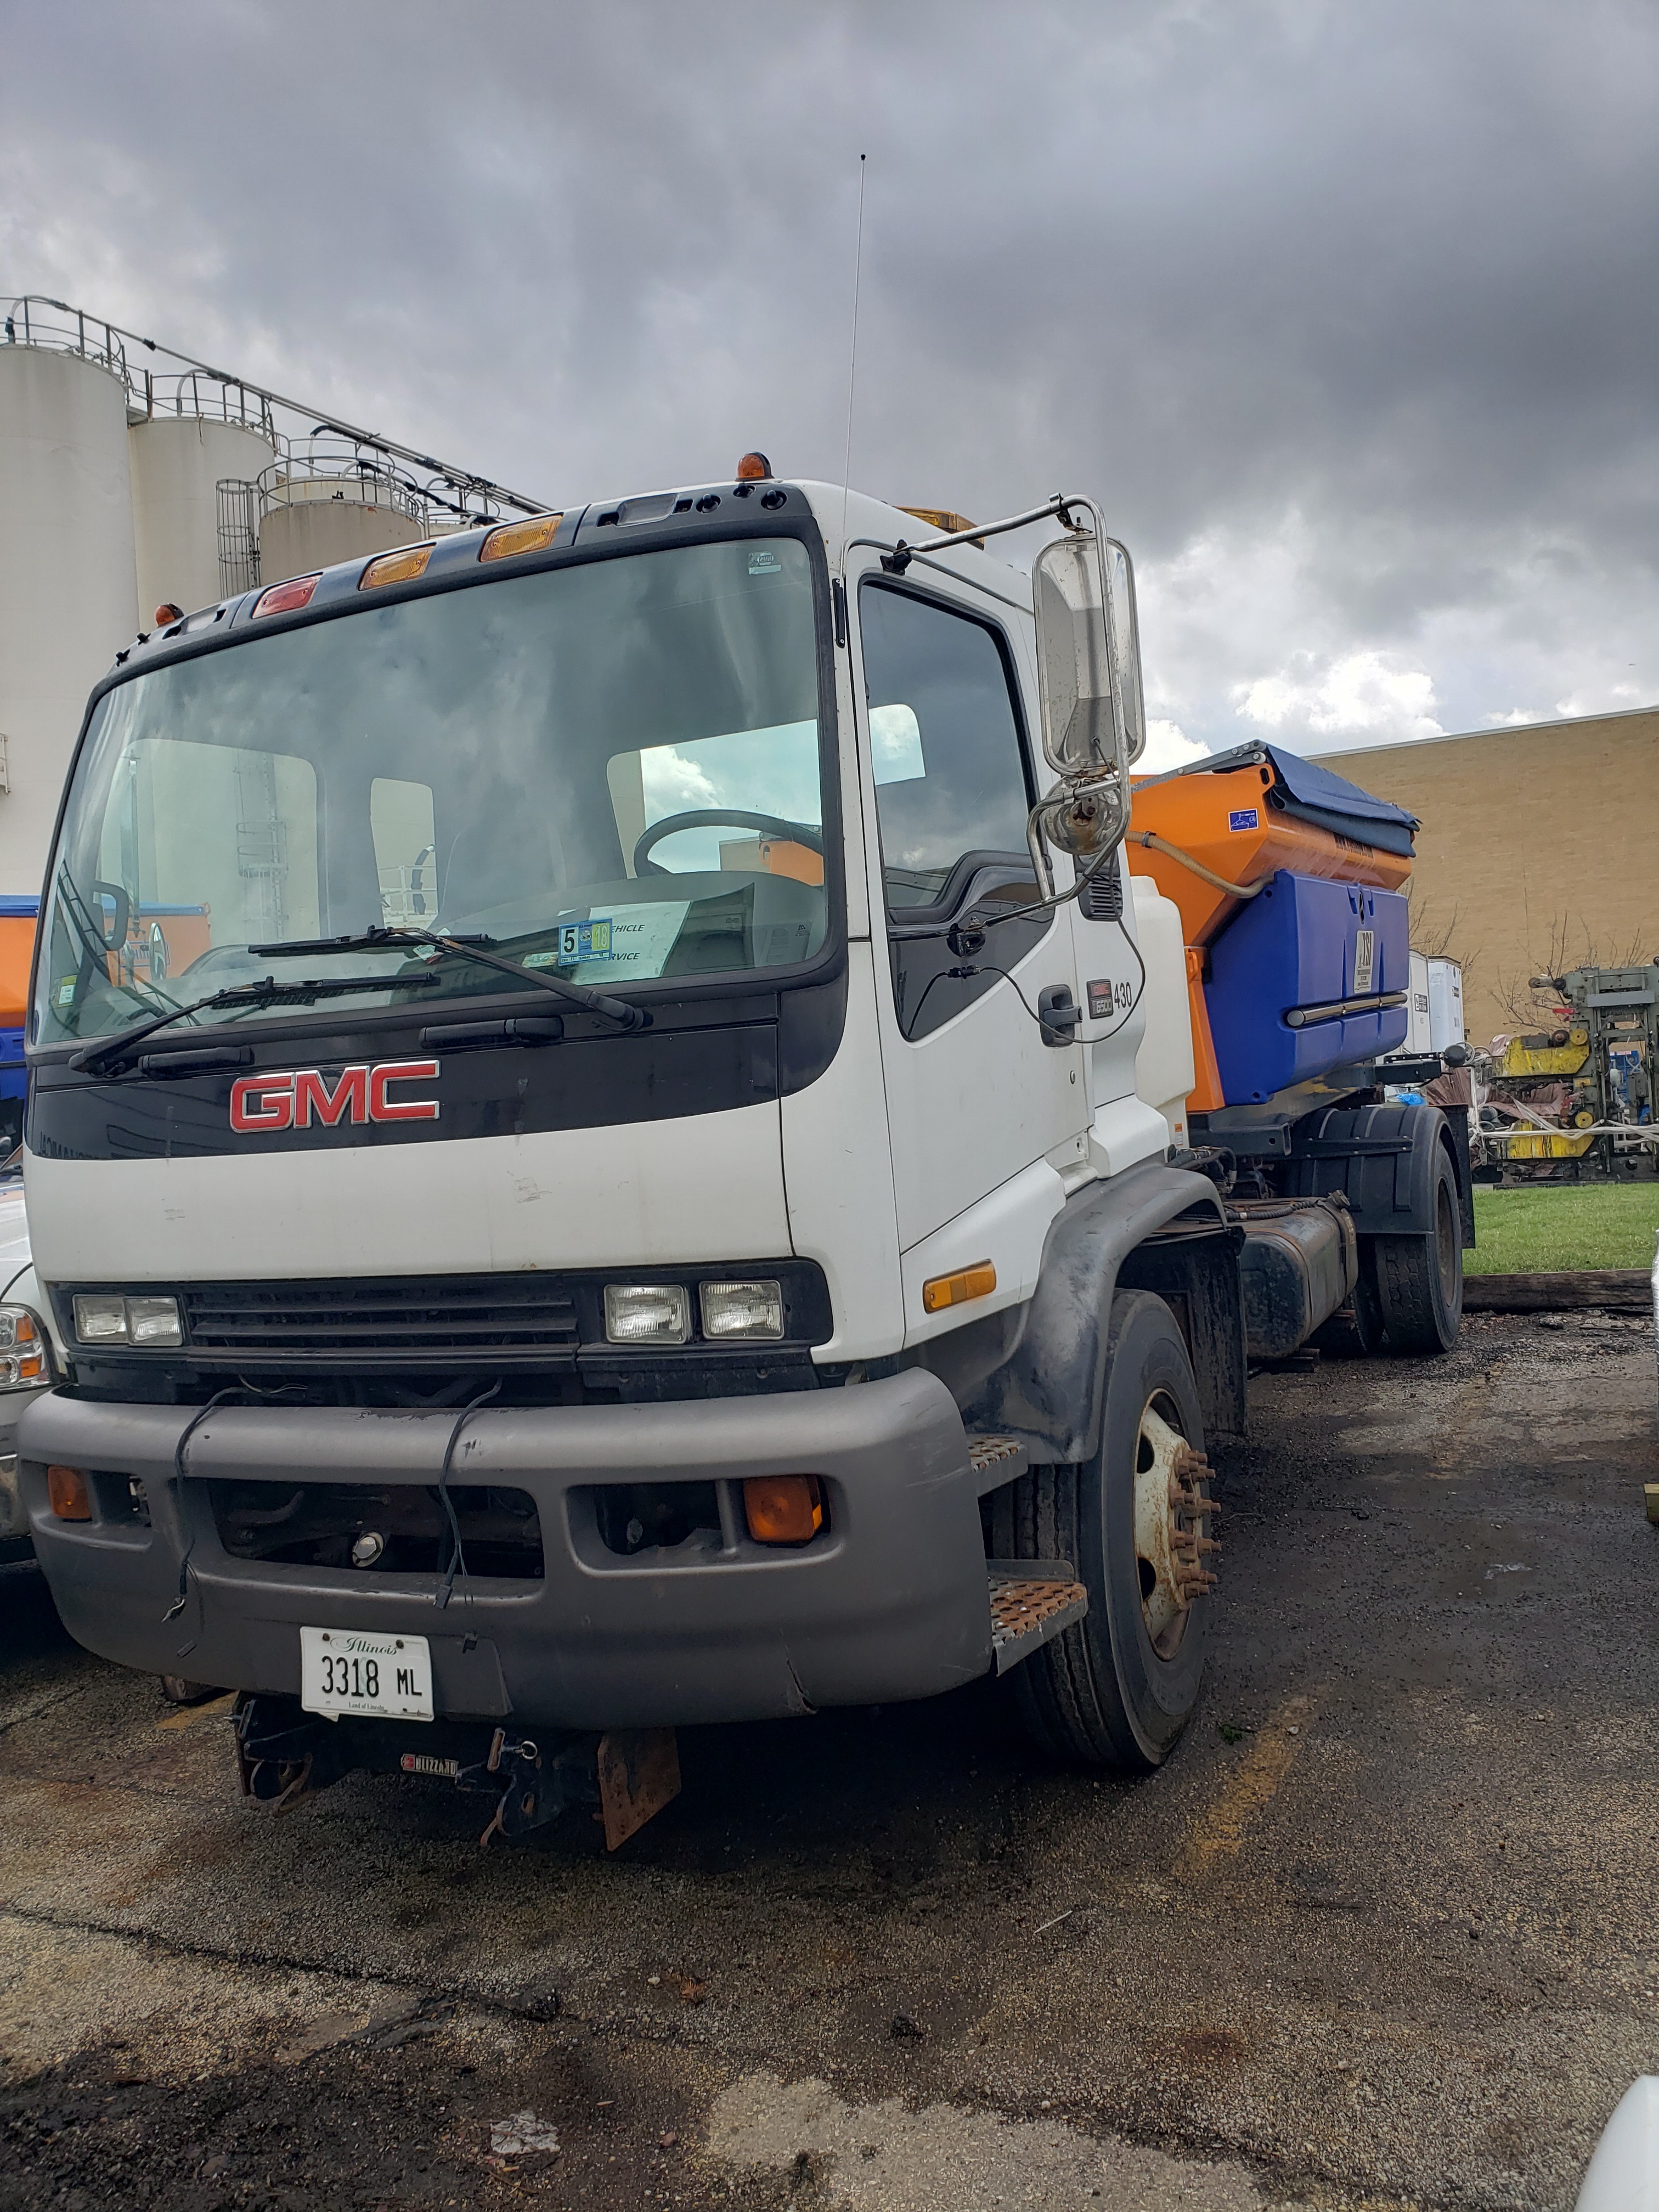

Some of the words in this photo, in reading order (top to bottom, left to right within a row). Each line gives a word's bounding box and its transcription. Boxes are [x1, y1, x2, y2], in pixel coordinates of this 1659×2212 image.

[596, 924, 608, 949] 18
[612, 924, 645, 933] EHICLE
[564, 929, 575, 953] 5
[608, 952, 640, 961] RVICE
[1114, 981, 1132, 1008] 430
[229, 1059, 441, 1133] GMC
[330, 1637, 397, 1655] Illinois
[321, 1655, 379, 1697] 3318
[397, 1668, 422, 1697] ML
[367, 1703, 385, 1711] Lincoln
[415, 1757, 456, 1775] BLIZZARD
